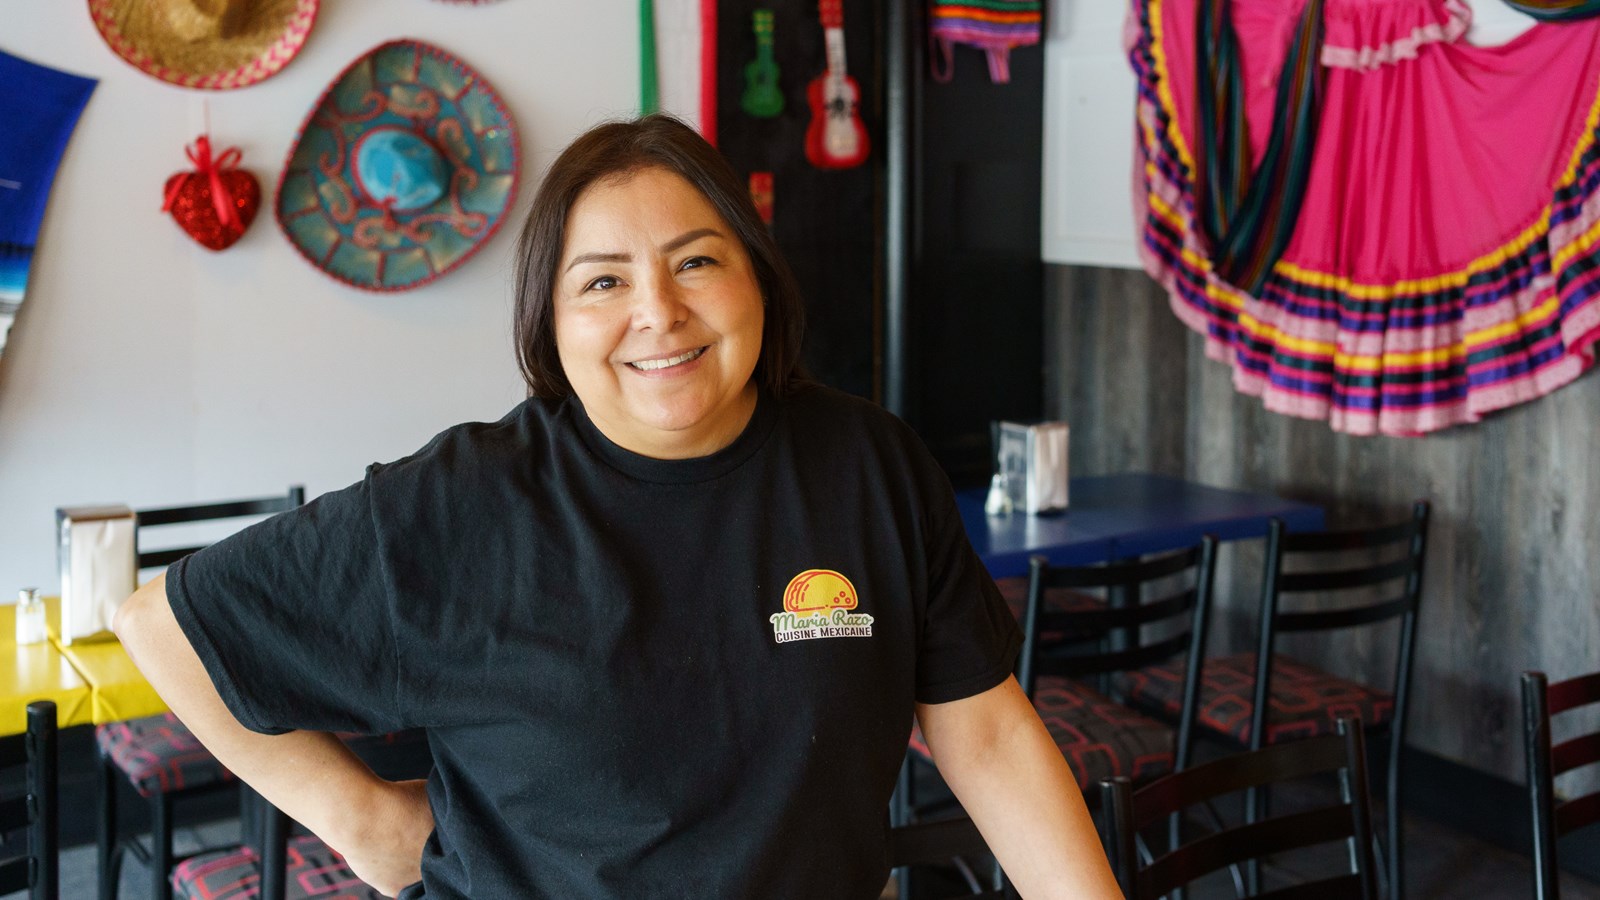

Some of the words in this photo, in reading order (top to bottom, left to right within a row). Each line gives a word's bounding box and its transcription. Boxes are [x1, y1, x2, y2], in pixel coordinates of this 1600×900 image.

[772, 613, 829, 631] Maria
[832, 609, 871, 625] Razo
[776, 629, 816, 642] CUISINE
[820, 627, 870, 636] MEXICAINE
